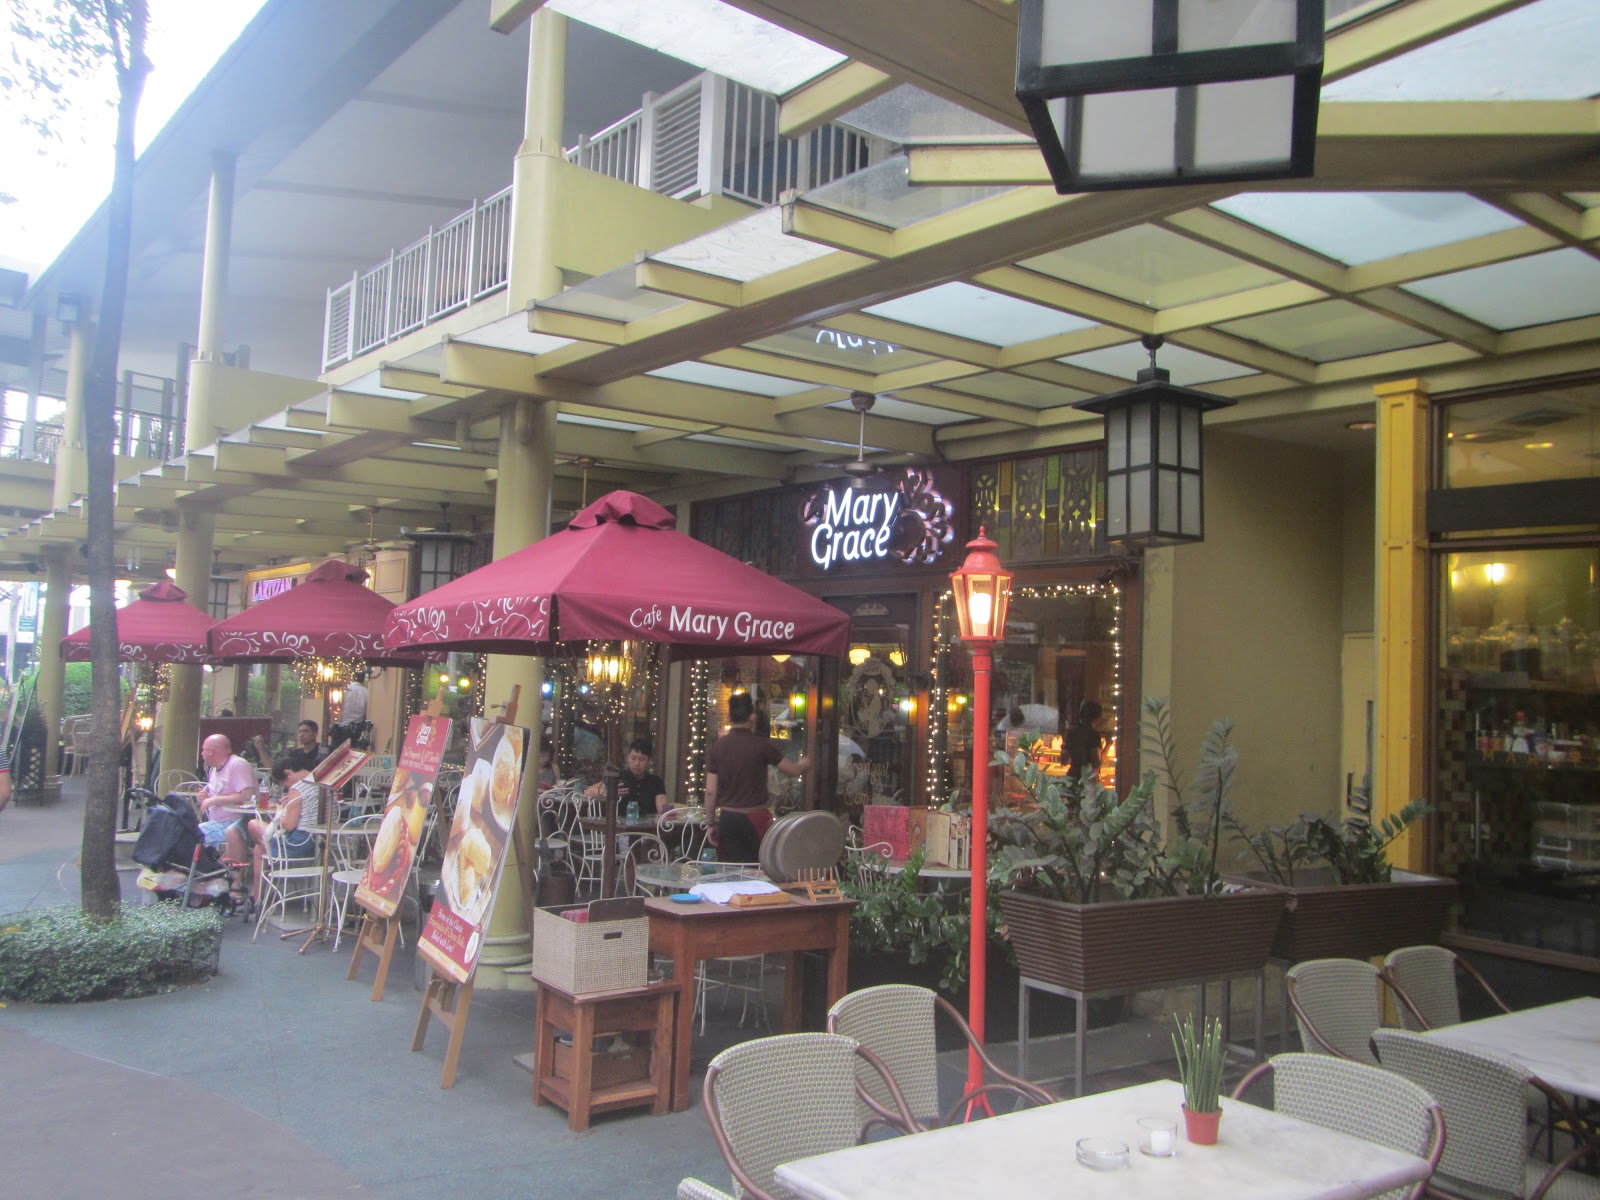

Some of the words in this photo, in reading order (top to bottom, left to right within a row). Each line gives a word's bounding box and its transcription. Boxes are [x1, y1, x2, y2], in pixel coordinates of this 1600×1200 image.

[825, 487, 898, 527] Mary
[811, 523, 890, 570] Grace
[629, 604, 662, 630] Cafe
[668, 605, 729, 640] Mary
[733, 611, 795, 642] Grace
